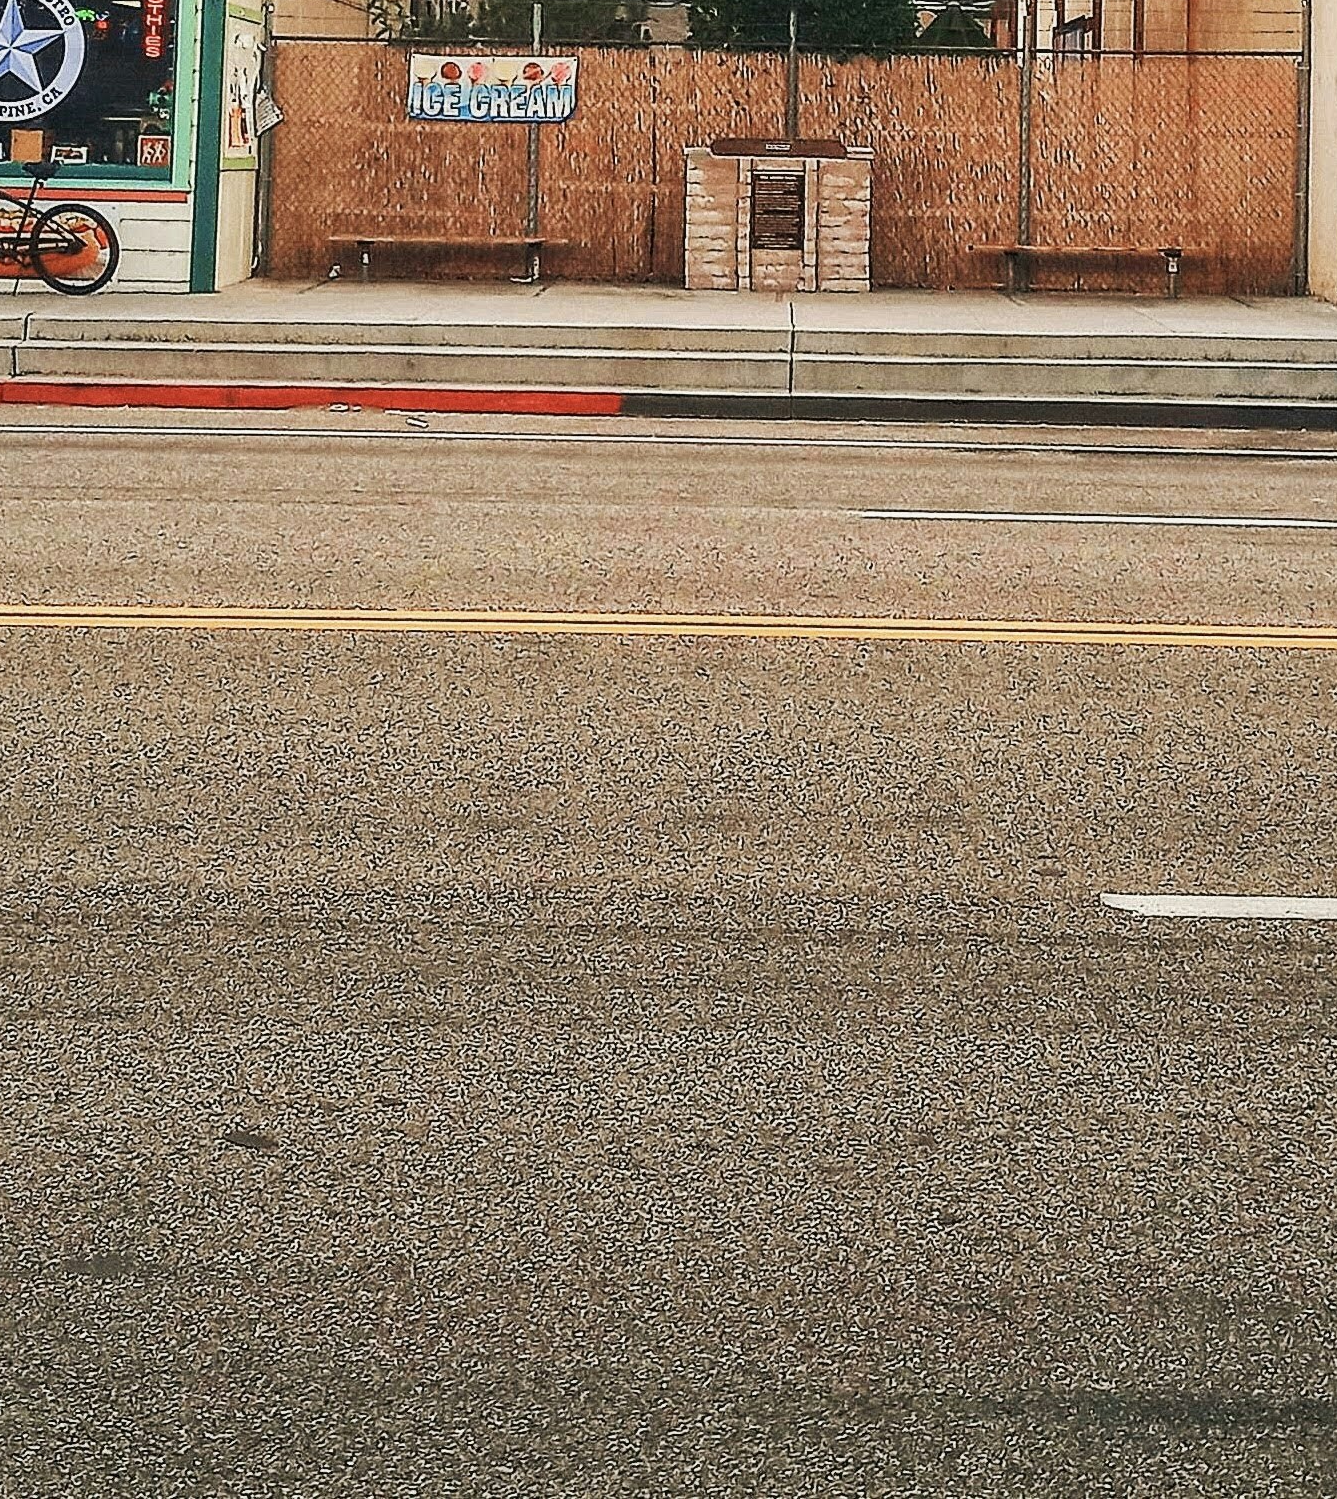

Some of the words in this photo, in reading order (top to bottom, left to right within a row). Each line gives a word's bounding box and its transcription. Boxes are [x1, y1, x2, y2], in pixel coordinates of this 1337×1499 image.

[42, 86, 63, 106] CA
[410, 82, 462, 117] ICE
[469, 83, 573, 119] CREAM
